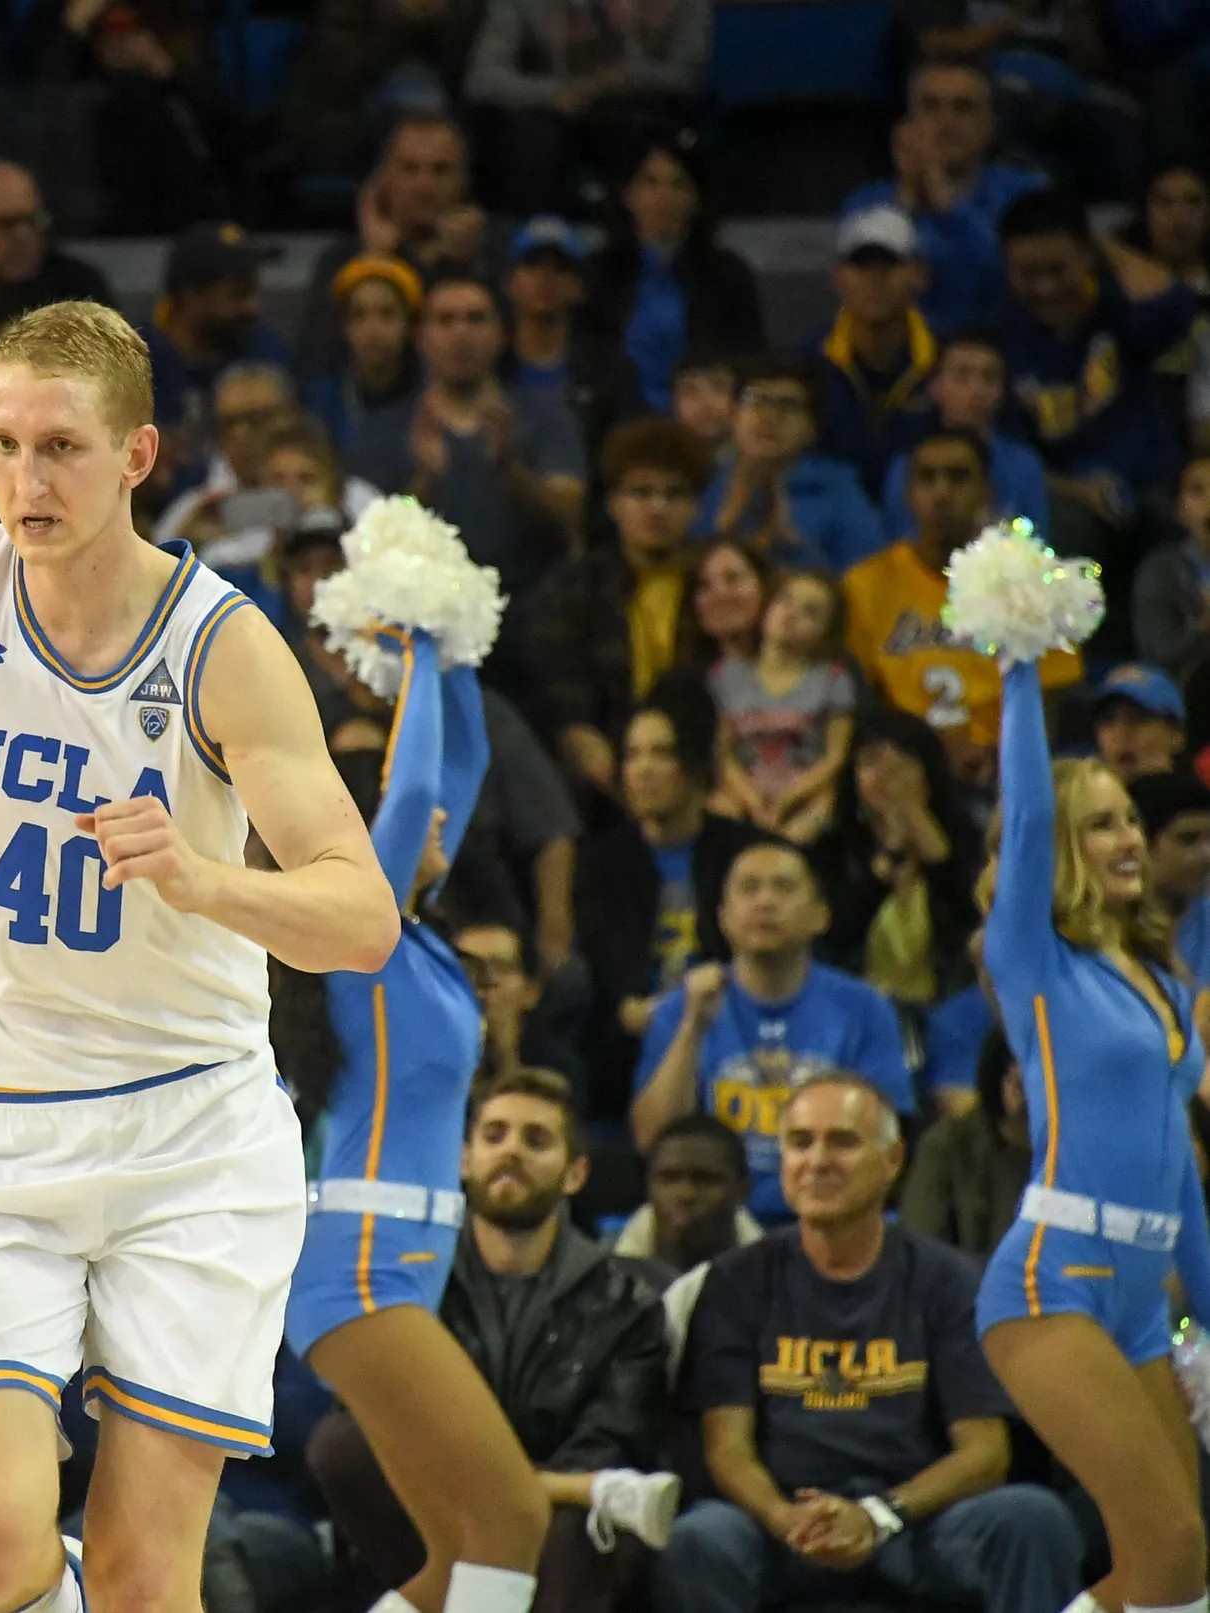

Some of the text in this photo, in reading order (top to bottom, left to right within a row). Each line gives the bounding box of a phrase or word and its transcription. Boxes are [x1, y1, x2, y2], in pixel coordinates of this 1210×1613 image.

[140, 683, 174, 698] JRW
[922, 664, 970, 727] 2
[146, 721, 161, 735] 12
[776, 1335, 898, 1377] UCLA
